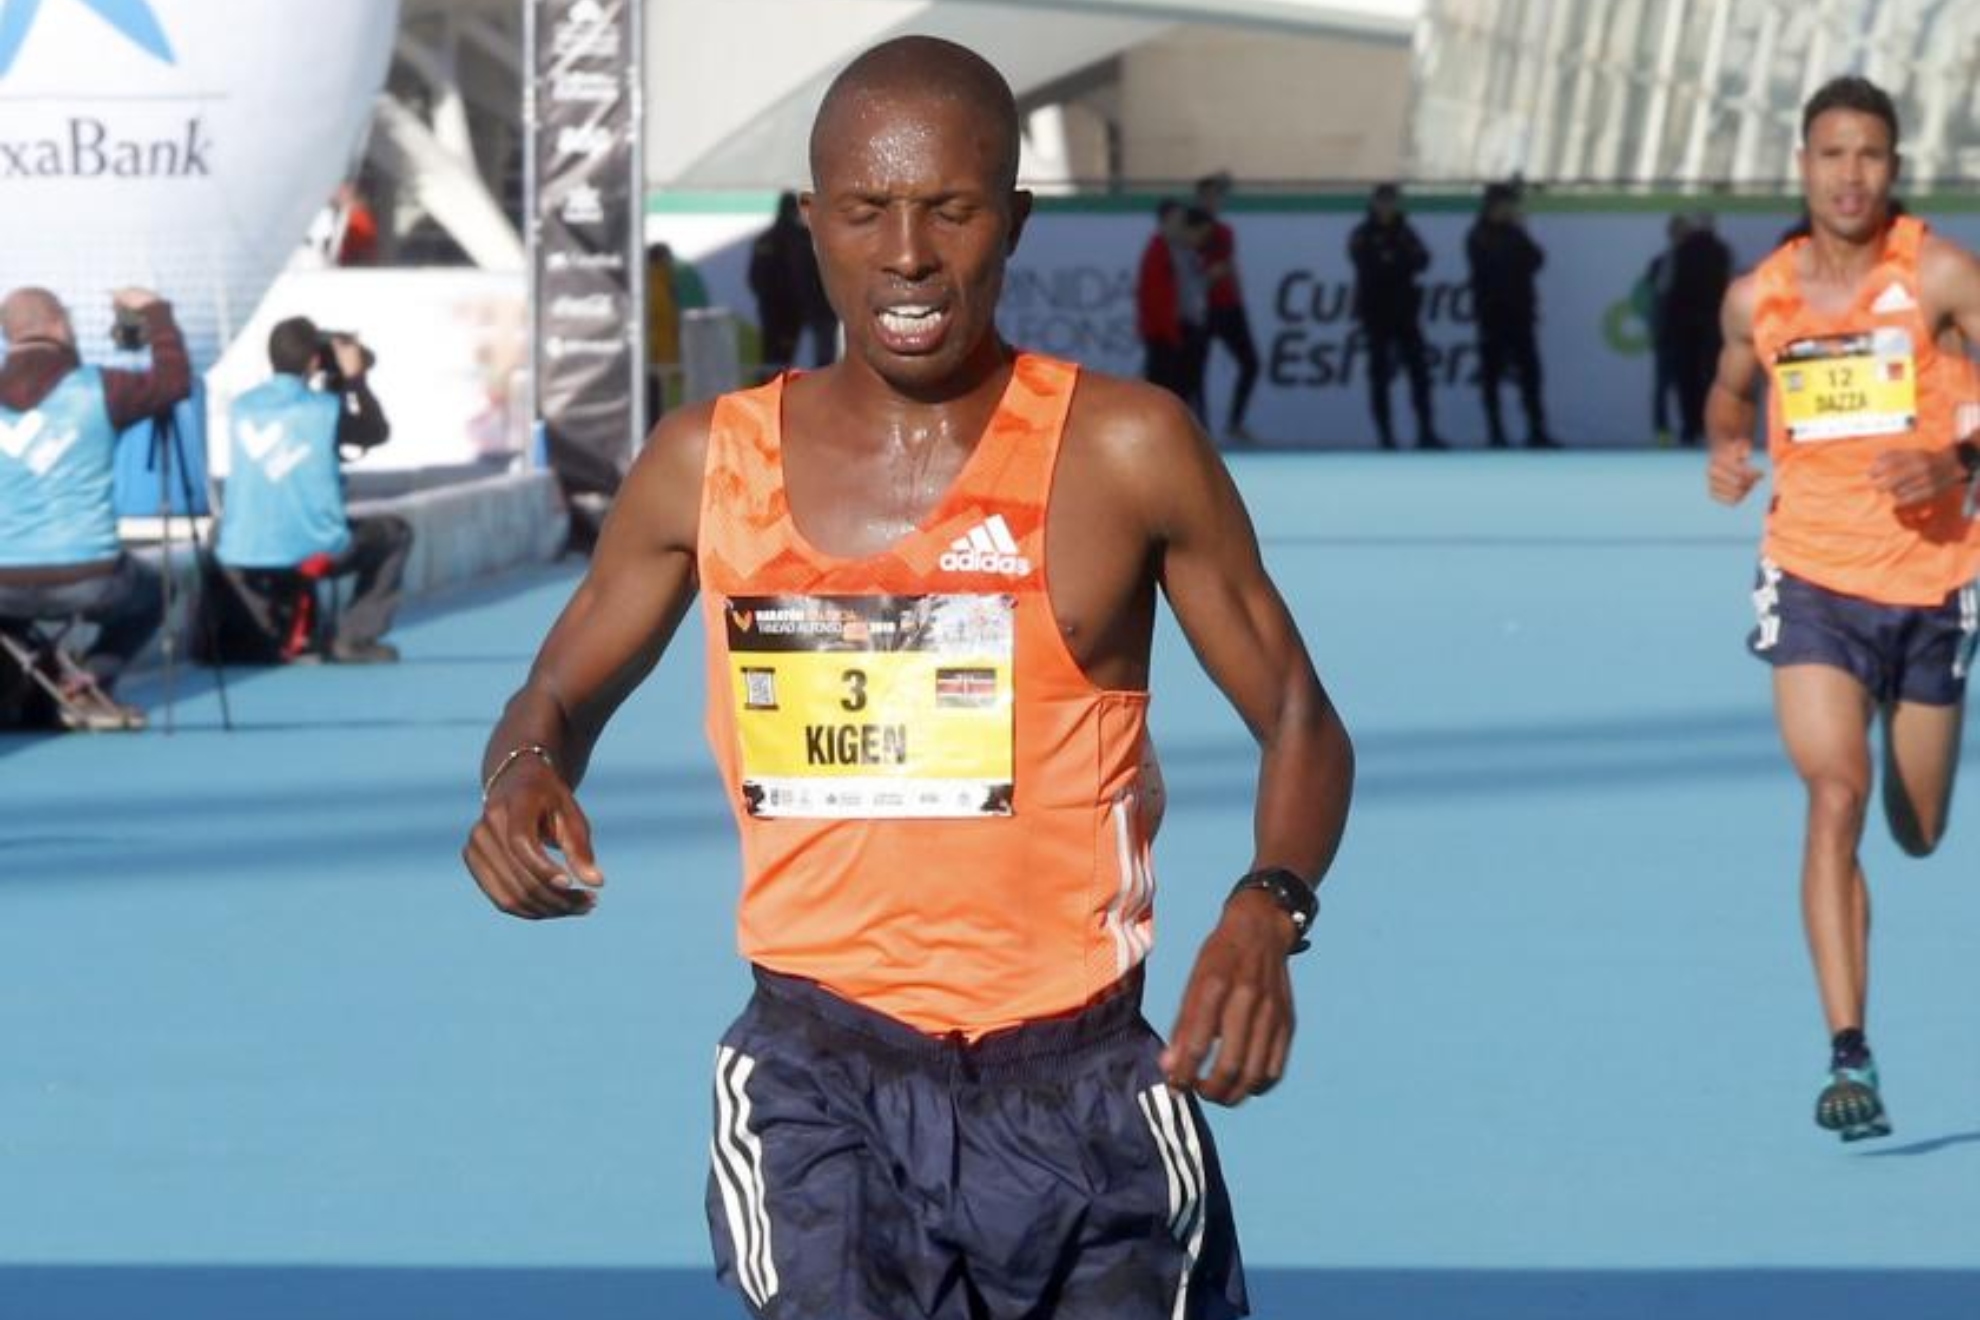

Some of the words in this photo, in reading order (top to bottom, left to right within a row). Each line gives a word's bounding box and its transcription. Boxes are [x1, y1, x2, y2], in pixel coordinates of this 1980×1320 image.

[0, 117, 212, 176] xaBank
[1829, 367, 1853, 387] 12
[940, 551, 1030, 577] adidas
[840, 668, 869, 713] 3
[805, 723, 907, 765] KIGEN
